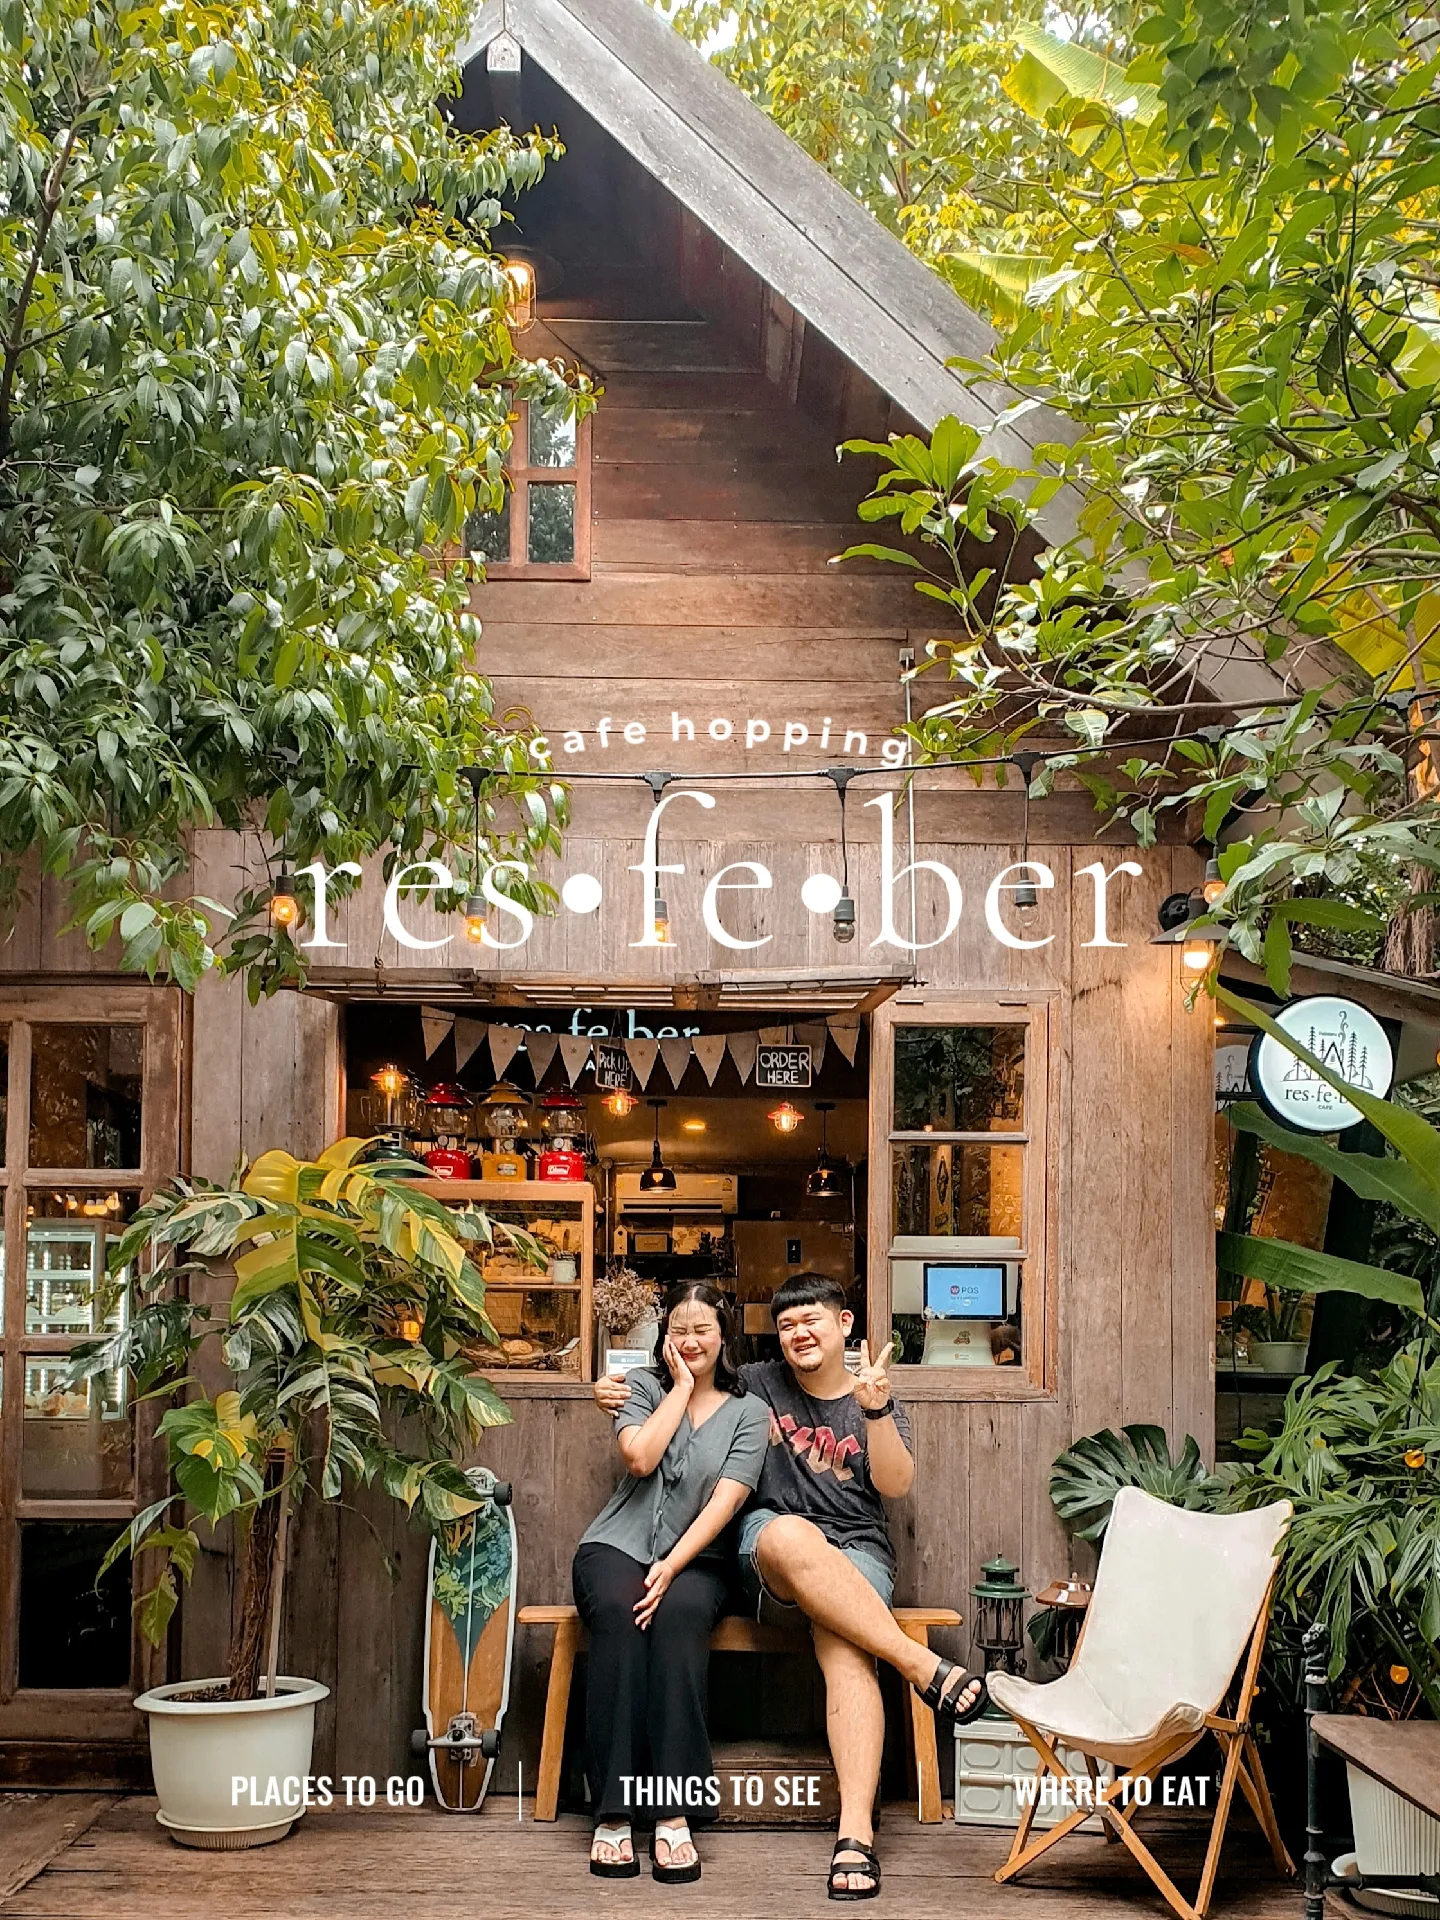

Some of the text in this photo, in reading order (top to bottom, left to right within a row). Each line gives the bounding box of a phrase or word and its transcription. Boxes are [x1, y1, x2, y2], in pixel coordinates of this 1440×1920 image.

[760, 1051, 809, 1071] ORDER
[604, 1070, 628, 1087] HERE
[767, 1070, 799, 1084] HERE
[961, 1286, 979, 1294] POS
